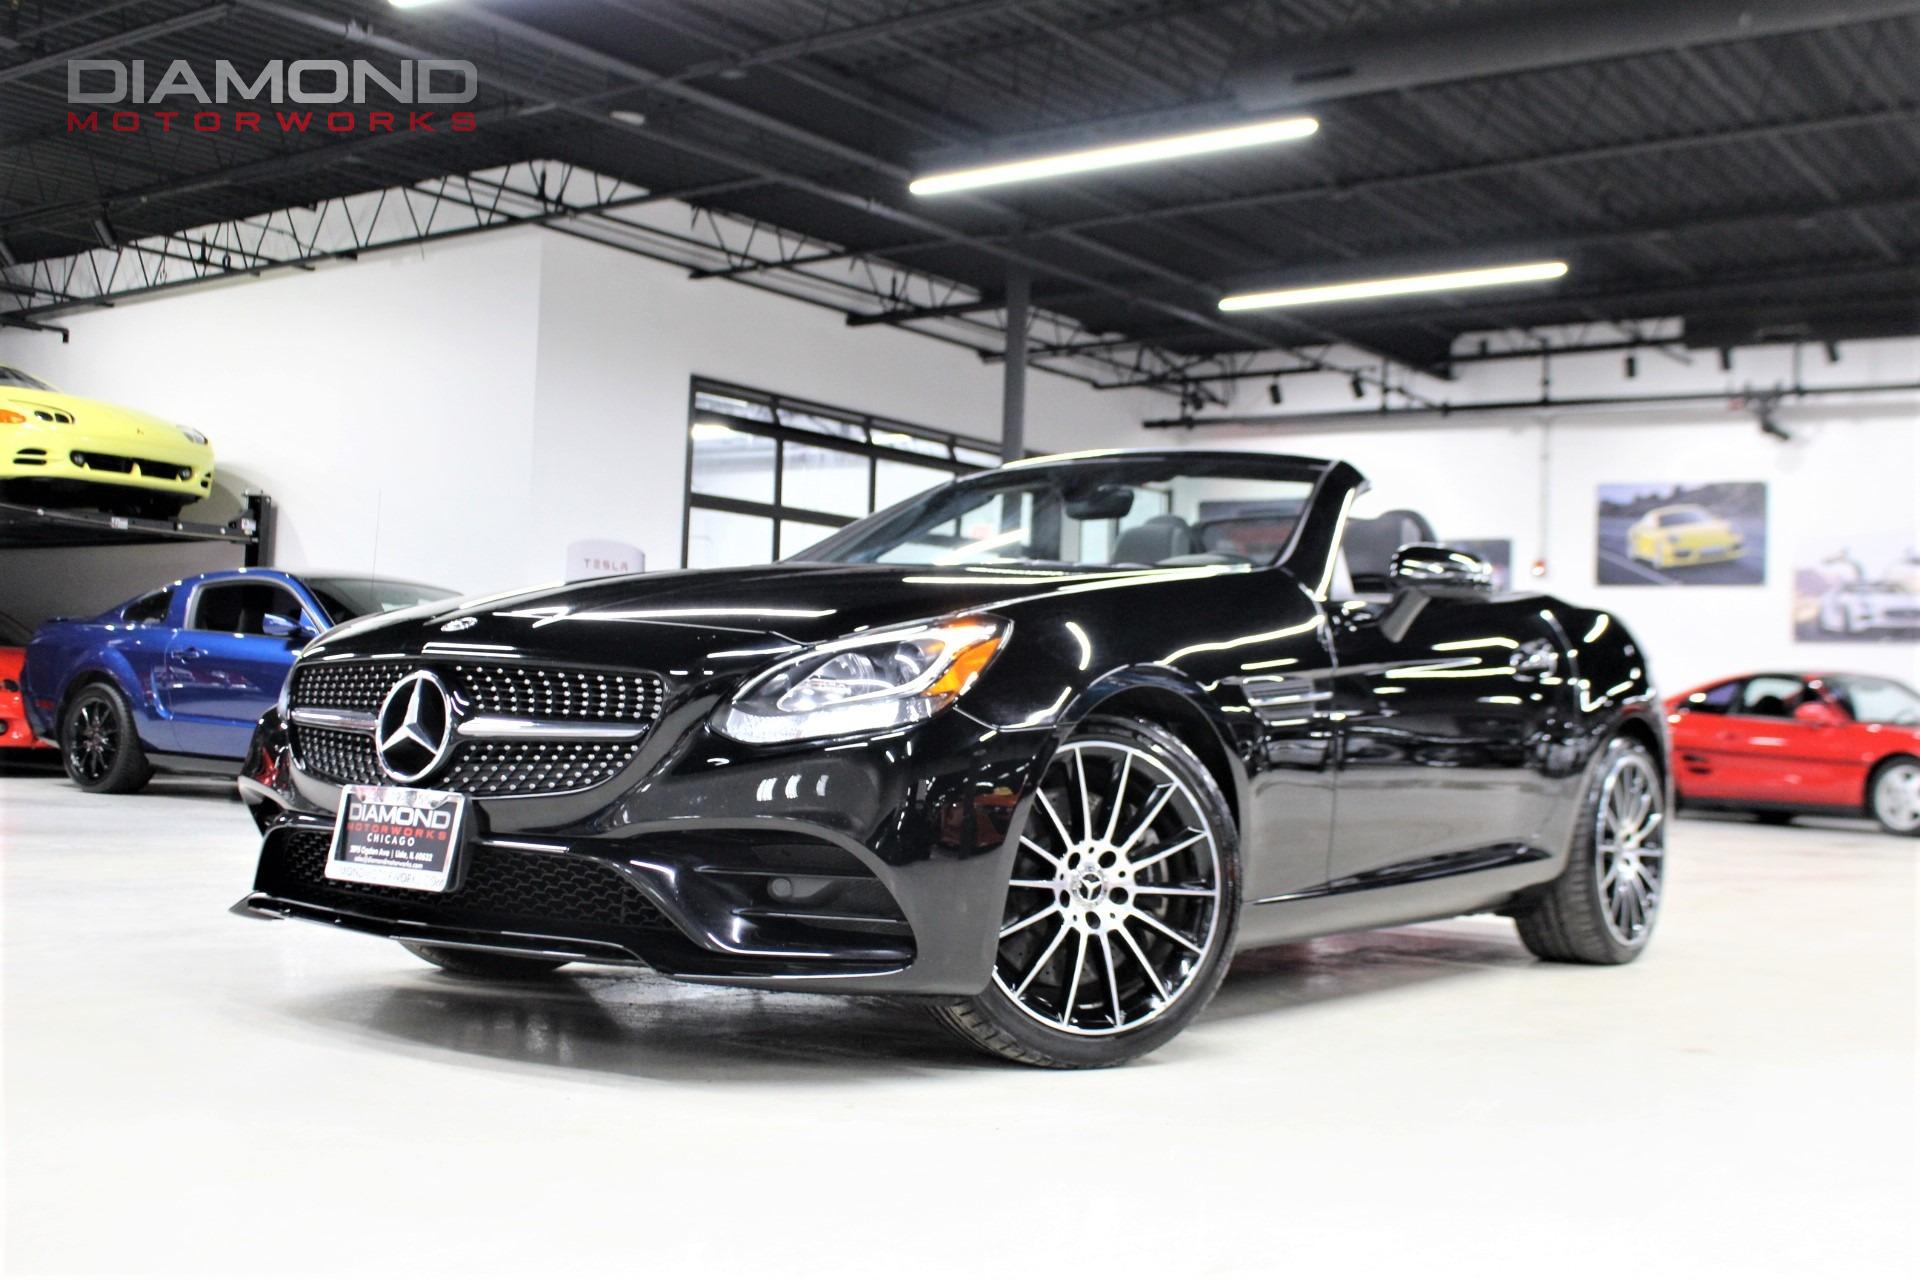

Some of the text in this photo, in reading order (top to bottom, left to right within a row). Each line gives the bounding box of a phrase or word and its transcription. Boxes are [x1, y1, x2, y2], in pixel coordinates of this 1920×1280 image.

[584, 558, 629, 572] TESLA
[349, 803, 451, 829] DIAMOND
[347, 822, 447, 841] MOTORWORKS
[367, 832, 416, 847] CHICAGO
